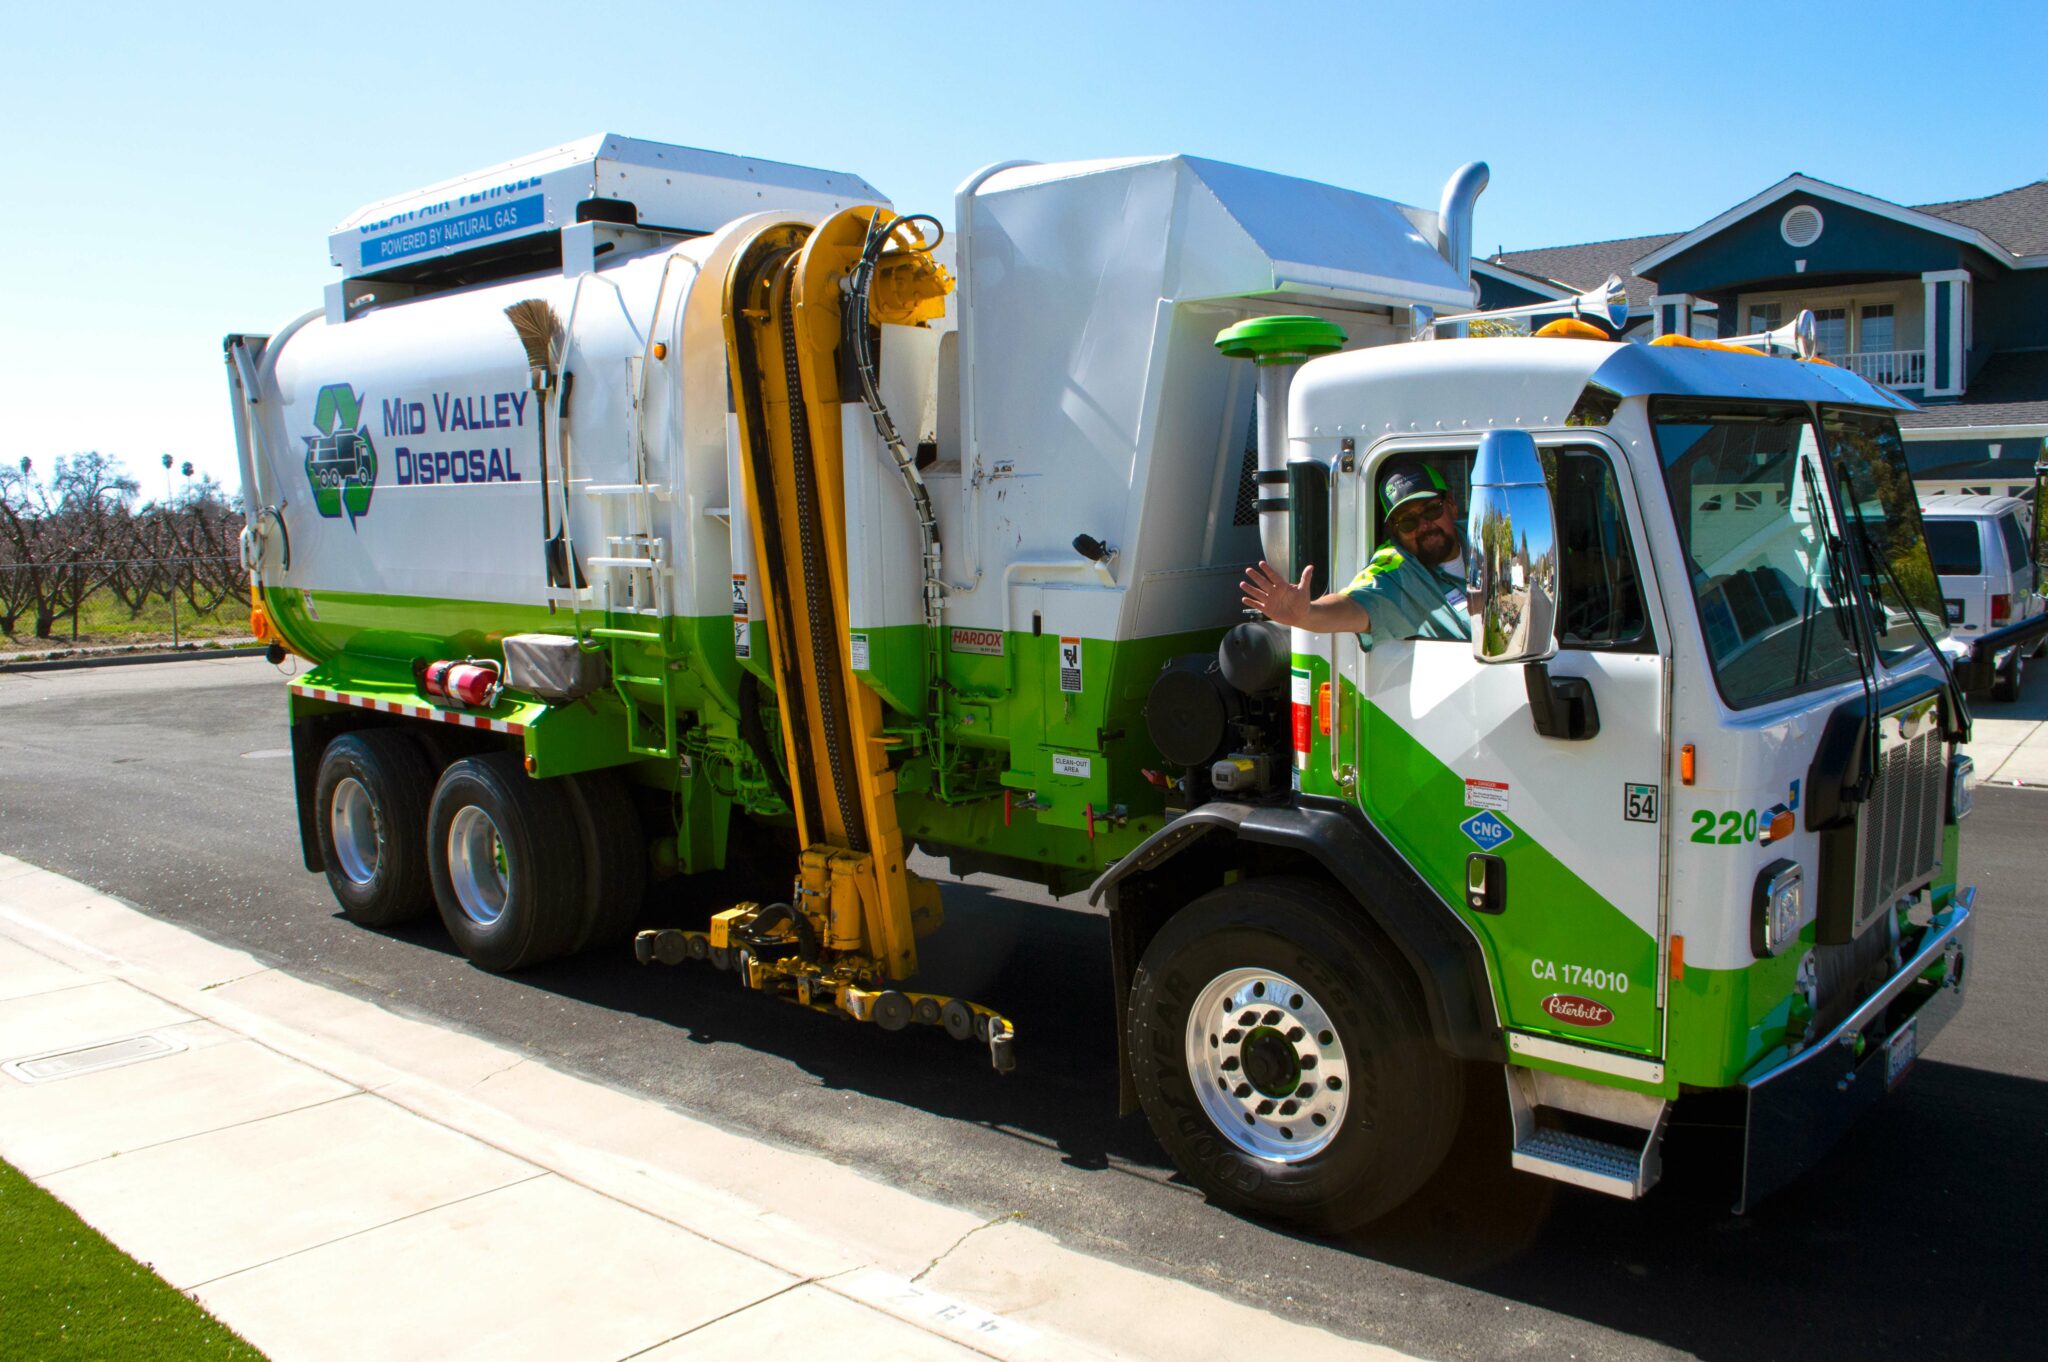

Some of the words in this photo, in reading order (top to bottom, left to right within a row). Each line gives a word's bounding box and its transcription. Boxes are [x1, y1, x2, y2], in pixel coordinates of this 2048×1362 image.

[381, 232, 427, 257] POWERED
[429, 227, 442, 245] BY
[445, 215, 492, 240] NATURAL
[495, 207, 518, 229] GAS
[382, 397, 426, 437] MID
[433, 391, 529, 432] VALLEY
[395, 447, 521, 485] DISPOSAL
[952, 630, 1002, 647] HARDOX
[1055, 757, 1088, 768] CLEAN-OUT
[1064, 765, 1080, 773] AREA
[1629, 794, 1654, 819] 54
[1471, 820, 1502, 838] CNG
[1690, 808, 1757, 845] 220
[1531, 959, 1557, 982] CA
[1562, 964, 1628, 993] 174010
[1549, 997, 1607, 1021] Peterbilt
